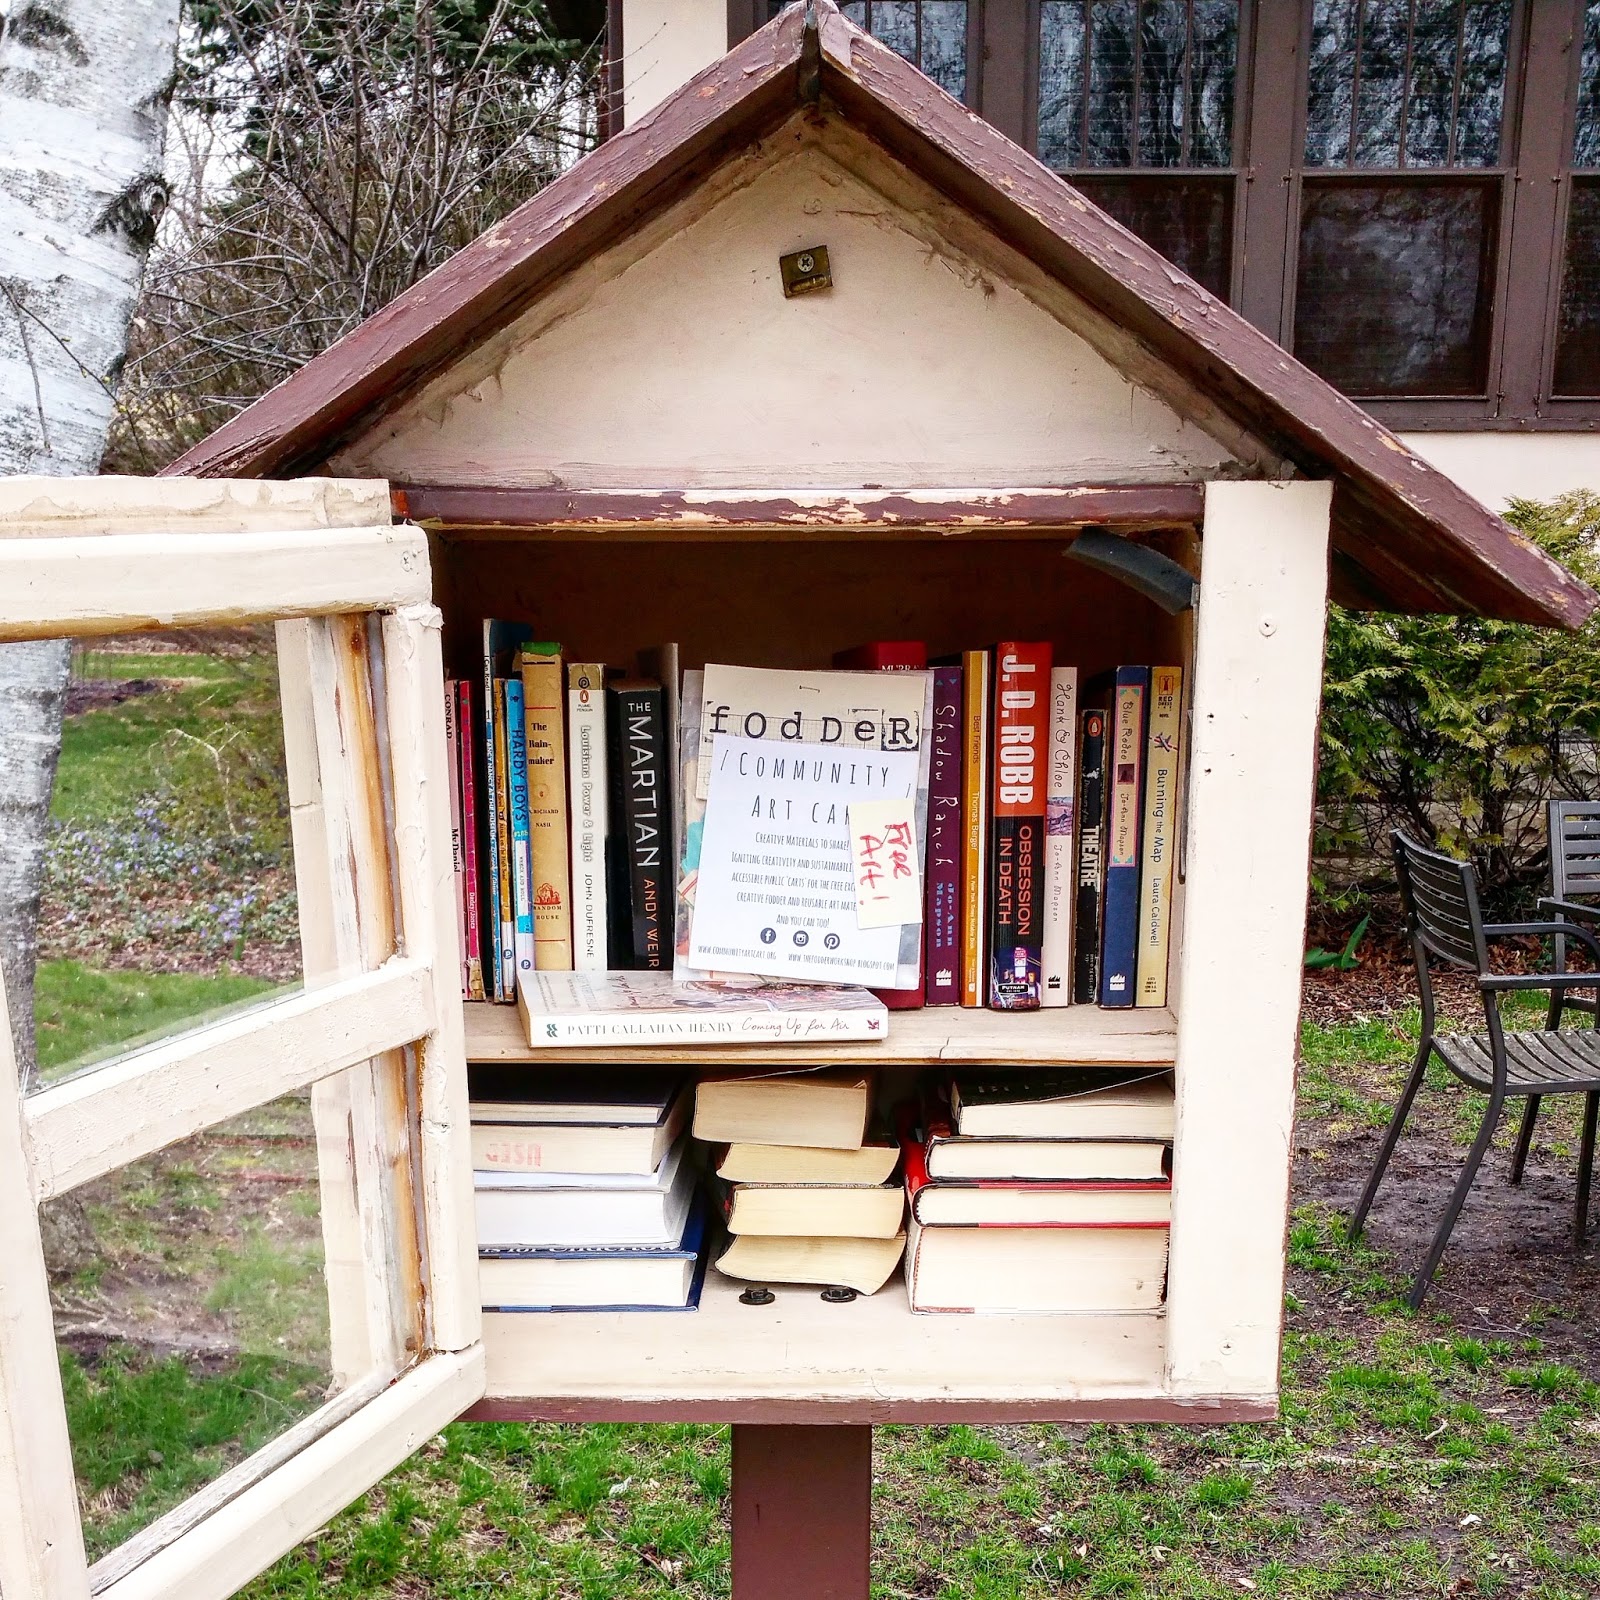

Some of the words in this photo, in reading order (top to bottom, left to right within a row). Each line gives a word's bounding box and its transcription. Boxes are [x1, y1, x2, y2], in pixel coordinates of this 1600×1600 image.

[1001, 655, 1035, 681] J.
[444, 694, 453, 739] CONRAD
[628, 702, 651, 711] THE
[1001, 691, 1035, 717] D.
[1055, 683, 1073, 724] Hank
[1122, 701, 1134, 724] Blue
[531, 722, 547, 731] The
[973, 715, 981, 732] Best
[512, 730, 525, 780] HARDY
[529, 739, 551, 748] Rain-
[581, 726, 592, 778] Louisiana
[935, 704, 956, 781] Shadow
[972, 735, 980, 764] Friends
[1120, 728, 1133, 760] Rodeo
[528, 757, 554, 765] maker
[739, 751, 889, 788] COMMUNITY
[999, 725, 1035, 804] ROBB
[1054, 749, 1071, 788] Chloe
[513, 786, 527, 821] BOYS
[582, 783, 593, 816] Power
[628, 716, 660, 868] MARTIAN
[751, 794, 793, 820] ART
[971, 791, 979, 822] Thomas
[1152, 769, 1168, 818] Burning
[755, 831, 785, 846] CREATIVE
[786, 834, 819, 849] MATERIALS
[932, 795, 958, 866] Ranch
[970, 825, 978, 851] Berger
[1155, 821, 1164, 833] the
[582, 834, 593, 862] Light
[731, 851, 761, 865] IGNITING
[762, 854, 796, 868] CREATIVITY
[797, 858, 810, 869] AND
[885, 821, 912, 880] Free
[998, 837, 1013, 857] IN
[1080, 825, 1101, 887] THEATRE
[1151, 836, 1164, 863] Map
[585, 874, 594, 900] JOHN
[731, 872, 763, 885] ACCESSIBLE
[764, 874, 785, 887] PUBLIC
[998, 862, 1013, 925] DEATH
[1017, 825, 1032, 936] OBSESSION
[1151, 878, 1162, 904] Laura
[644, 878, 657, 922] ANDY
[736, 891, 764, 904] CREATIVE
[765, 893, 786, 906] FODDER
[787, 896, 800, 907] AND
[585, 904, 595, 959] DUFRESNE
[1150, 906, 1161, 947] Caldwell
[647, 928, 660, 969] WEIR
[568, 1024, 608, 1035] PATTI
[612, 1022, 684, 1035] CALLAHAN
[689, 1021, 734, 1033] HENRY
[741, 1017, 781, 1037] Coming
[785, 1016, 802, 1034] Up
[805, 1018, 827, 1032] for
[830, 1017, 850, 1030] Air
